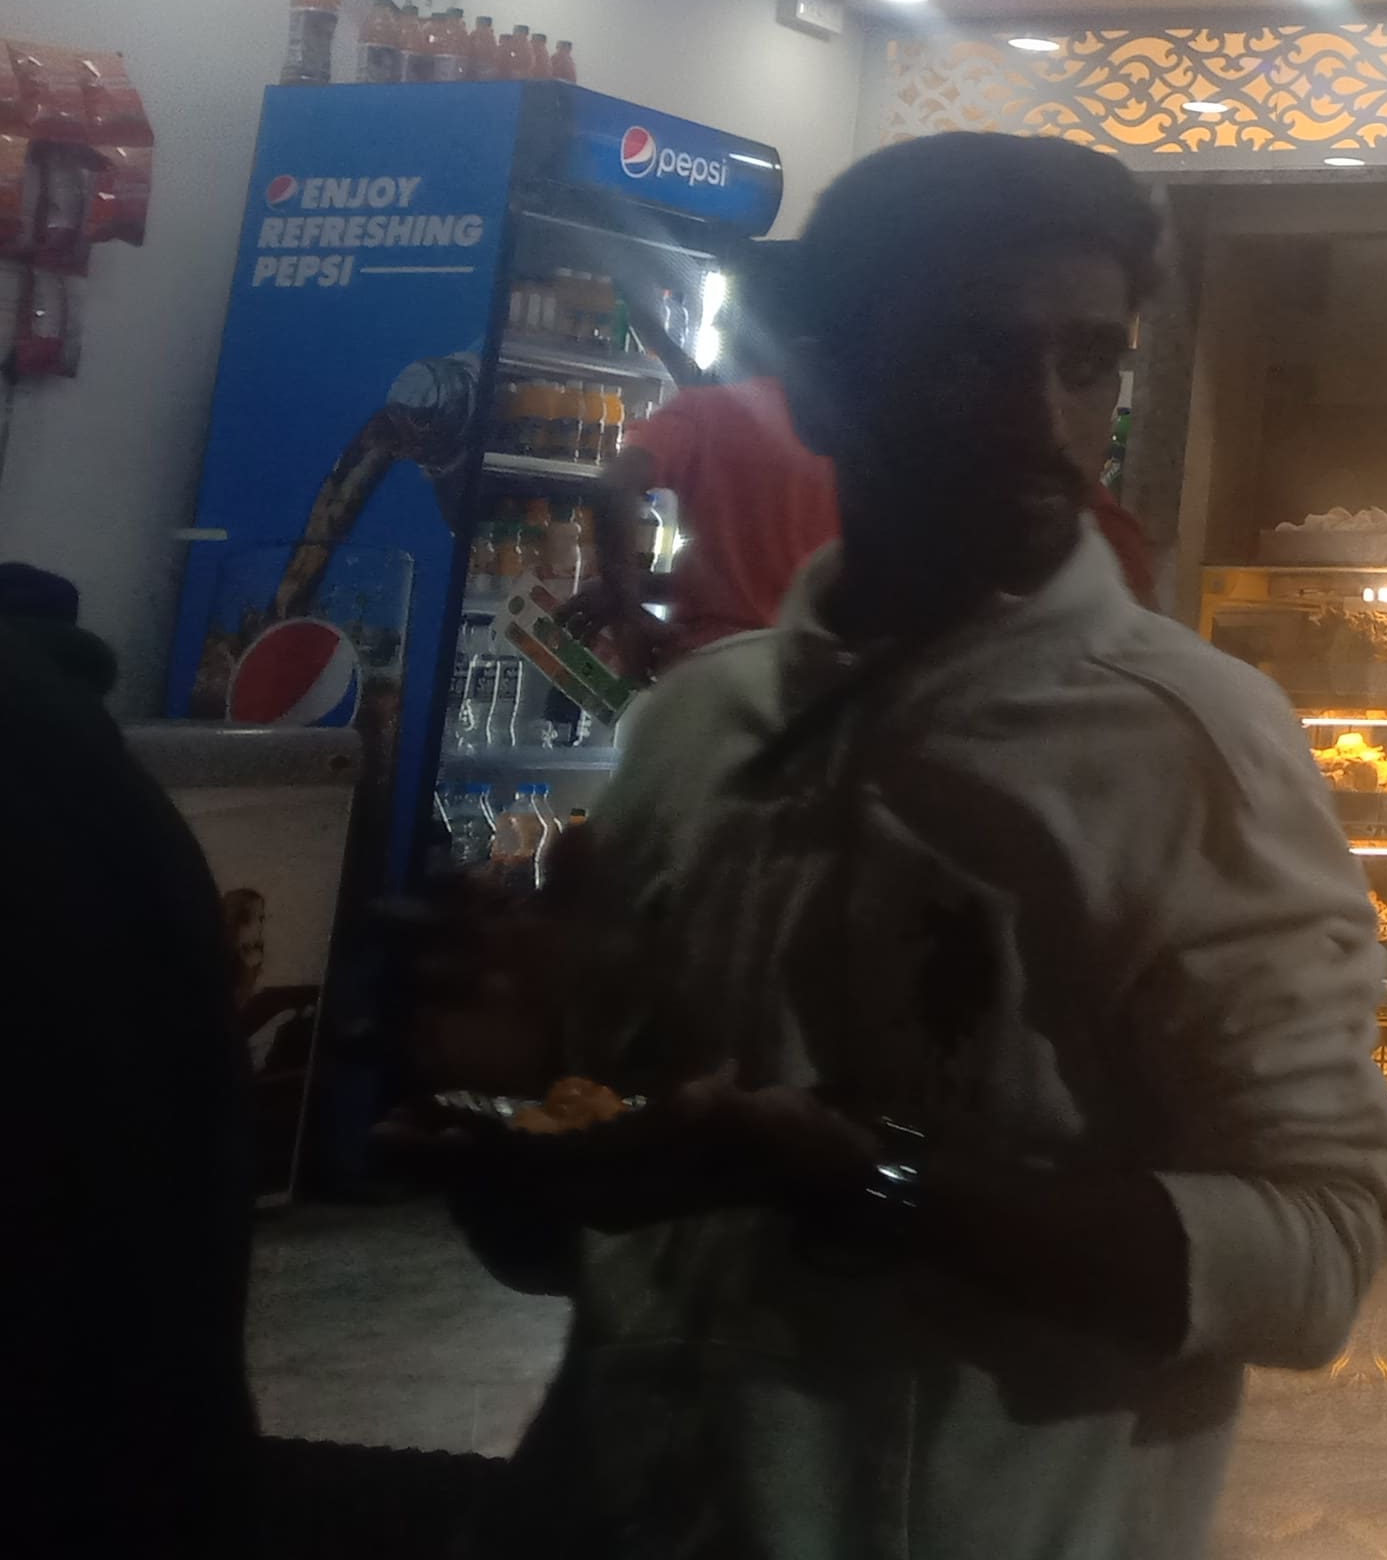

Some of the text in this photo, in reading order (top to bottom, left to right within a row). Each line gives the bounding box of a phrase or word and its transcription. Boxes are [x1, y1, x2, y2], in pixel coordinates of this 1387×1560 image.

[656, 147, 728, 187] pepsi
[301, 176, 421, 209] ENJOY
[257, 214, 484, 248] REFRESHING
[252, 254, 355, 287] PEPSI
